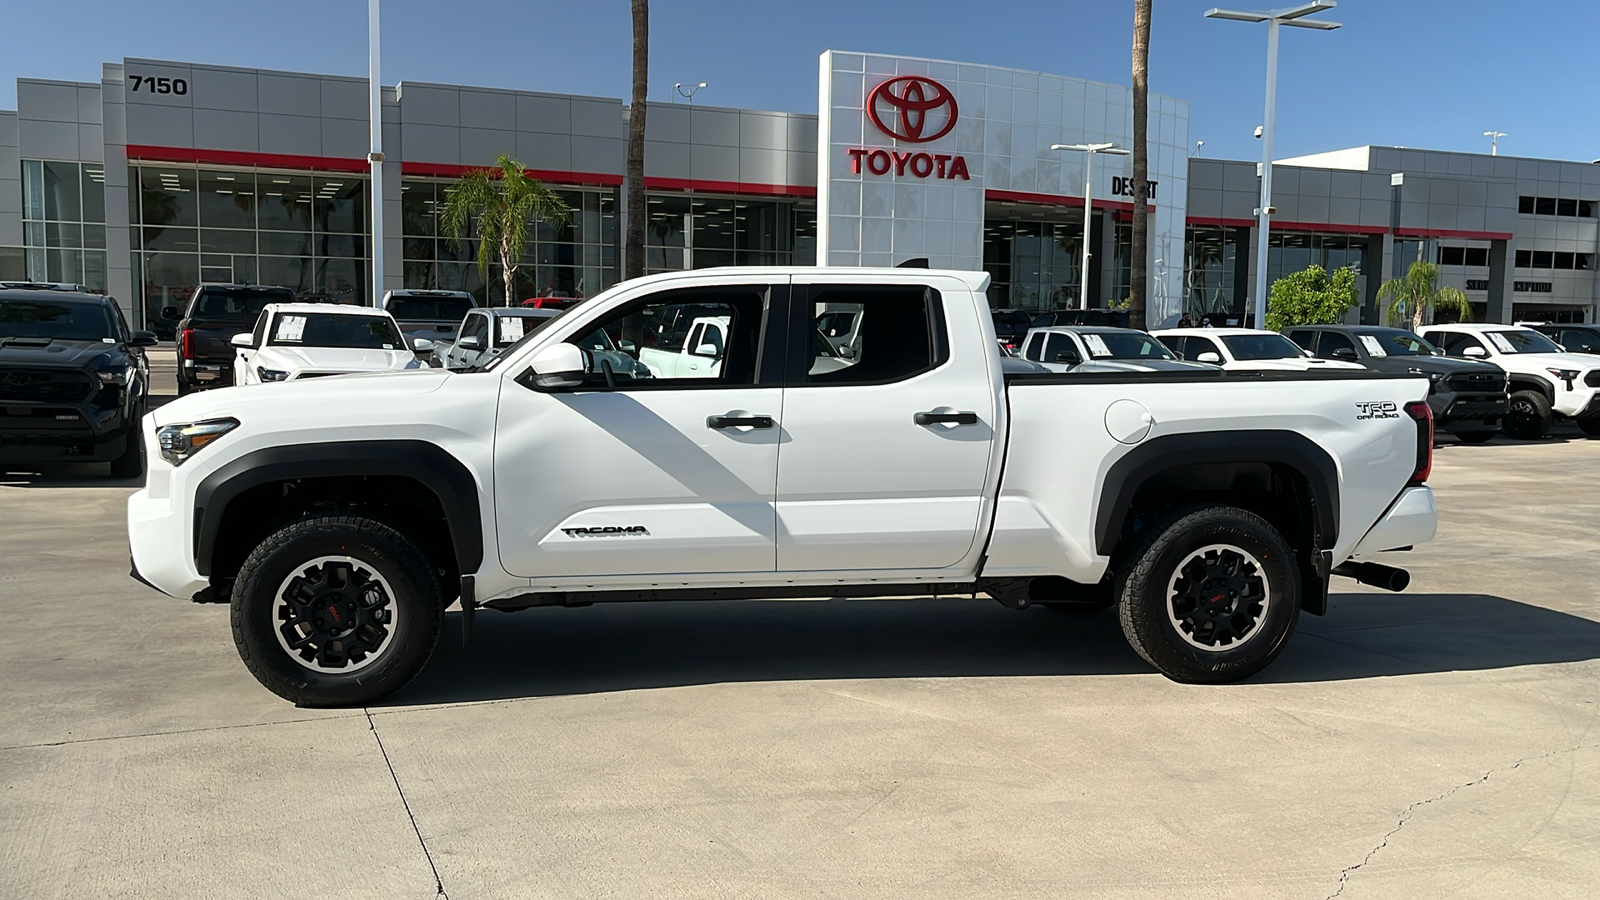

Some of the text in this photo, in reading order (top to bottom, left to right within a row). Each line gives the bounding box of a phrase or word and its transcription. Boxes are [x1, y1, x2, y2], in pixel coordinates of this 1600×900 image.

[129, 75, 187, 95] 7150
[847, 148, 970, 180] TOYOTA
[1112, 176, 1158, 199] DESRT
[1355, 401, 1397, 415] TRD
[560, 525, 647, 535] TACOMA
